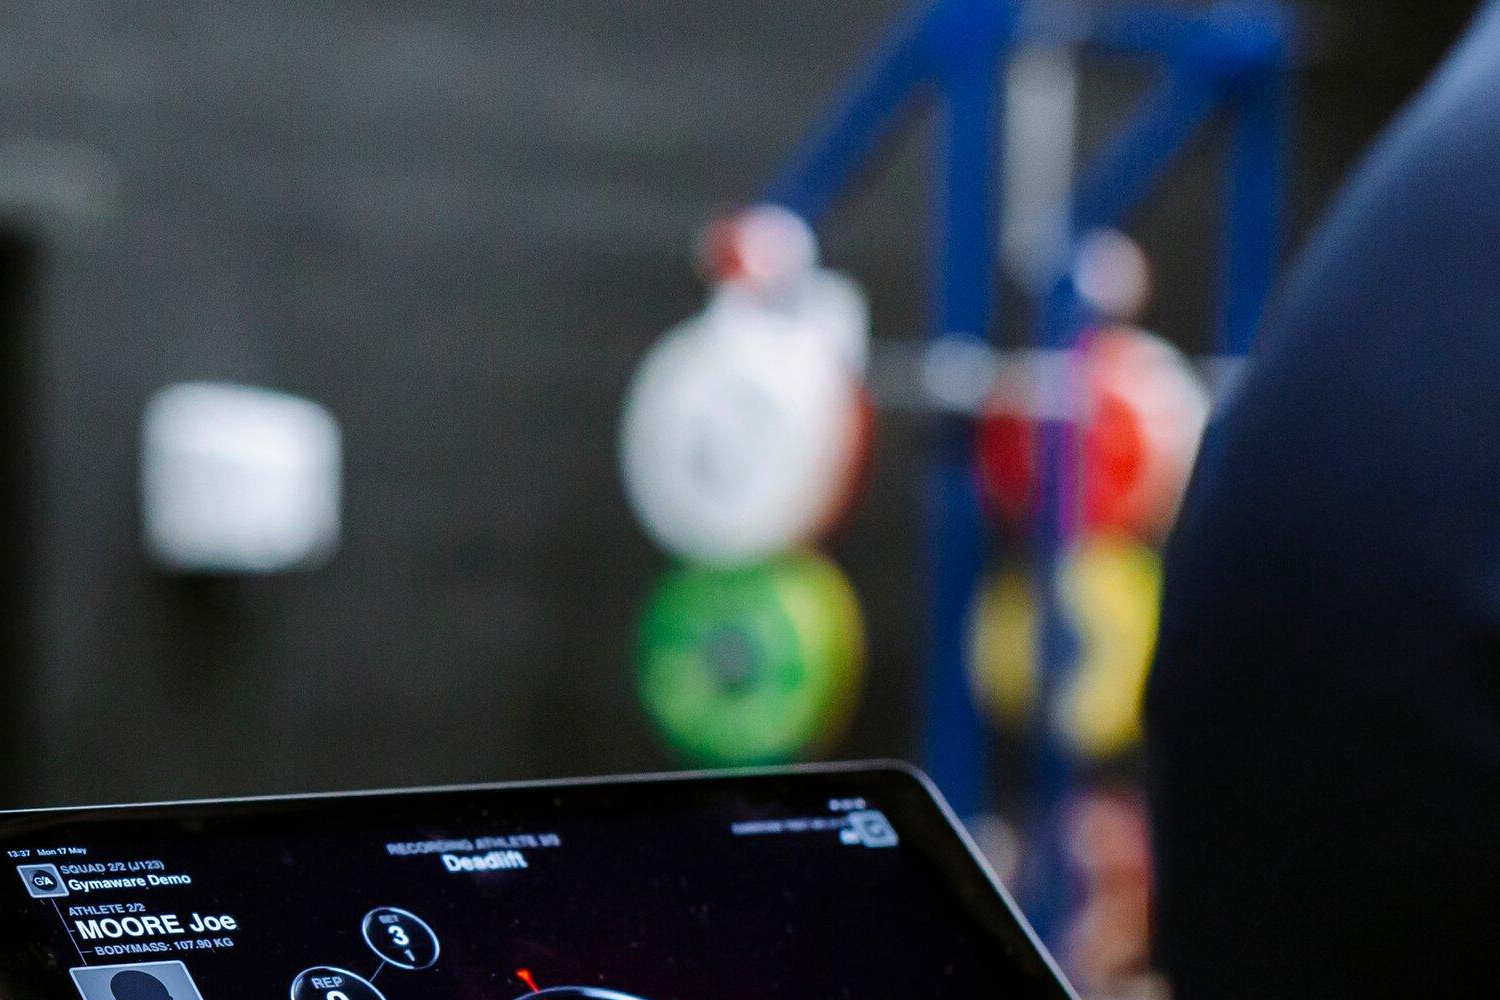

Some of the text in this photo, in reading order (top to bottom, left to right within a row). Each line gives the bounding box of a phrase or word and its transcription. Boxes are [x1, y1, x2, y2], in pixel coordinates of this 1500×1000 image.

[68, 847, 87, 855] May
[60, 860, 165, 875] SQUAD 2/2 (J123)
[442, 850, 528, 872] Deadlift
[68, 874, 192, 892] Gymaware Demo
[68, 903, 146, 917] ATHLETE 2/2
[74, 912, 238, 940] MOORE Joe
[388, 925, 409, 945] 3
[95, 937, 234, 956] BODYMASS: 107.90 KG
[404, 949, 415, 961] 1
[311, 976, 343, 989] REP
